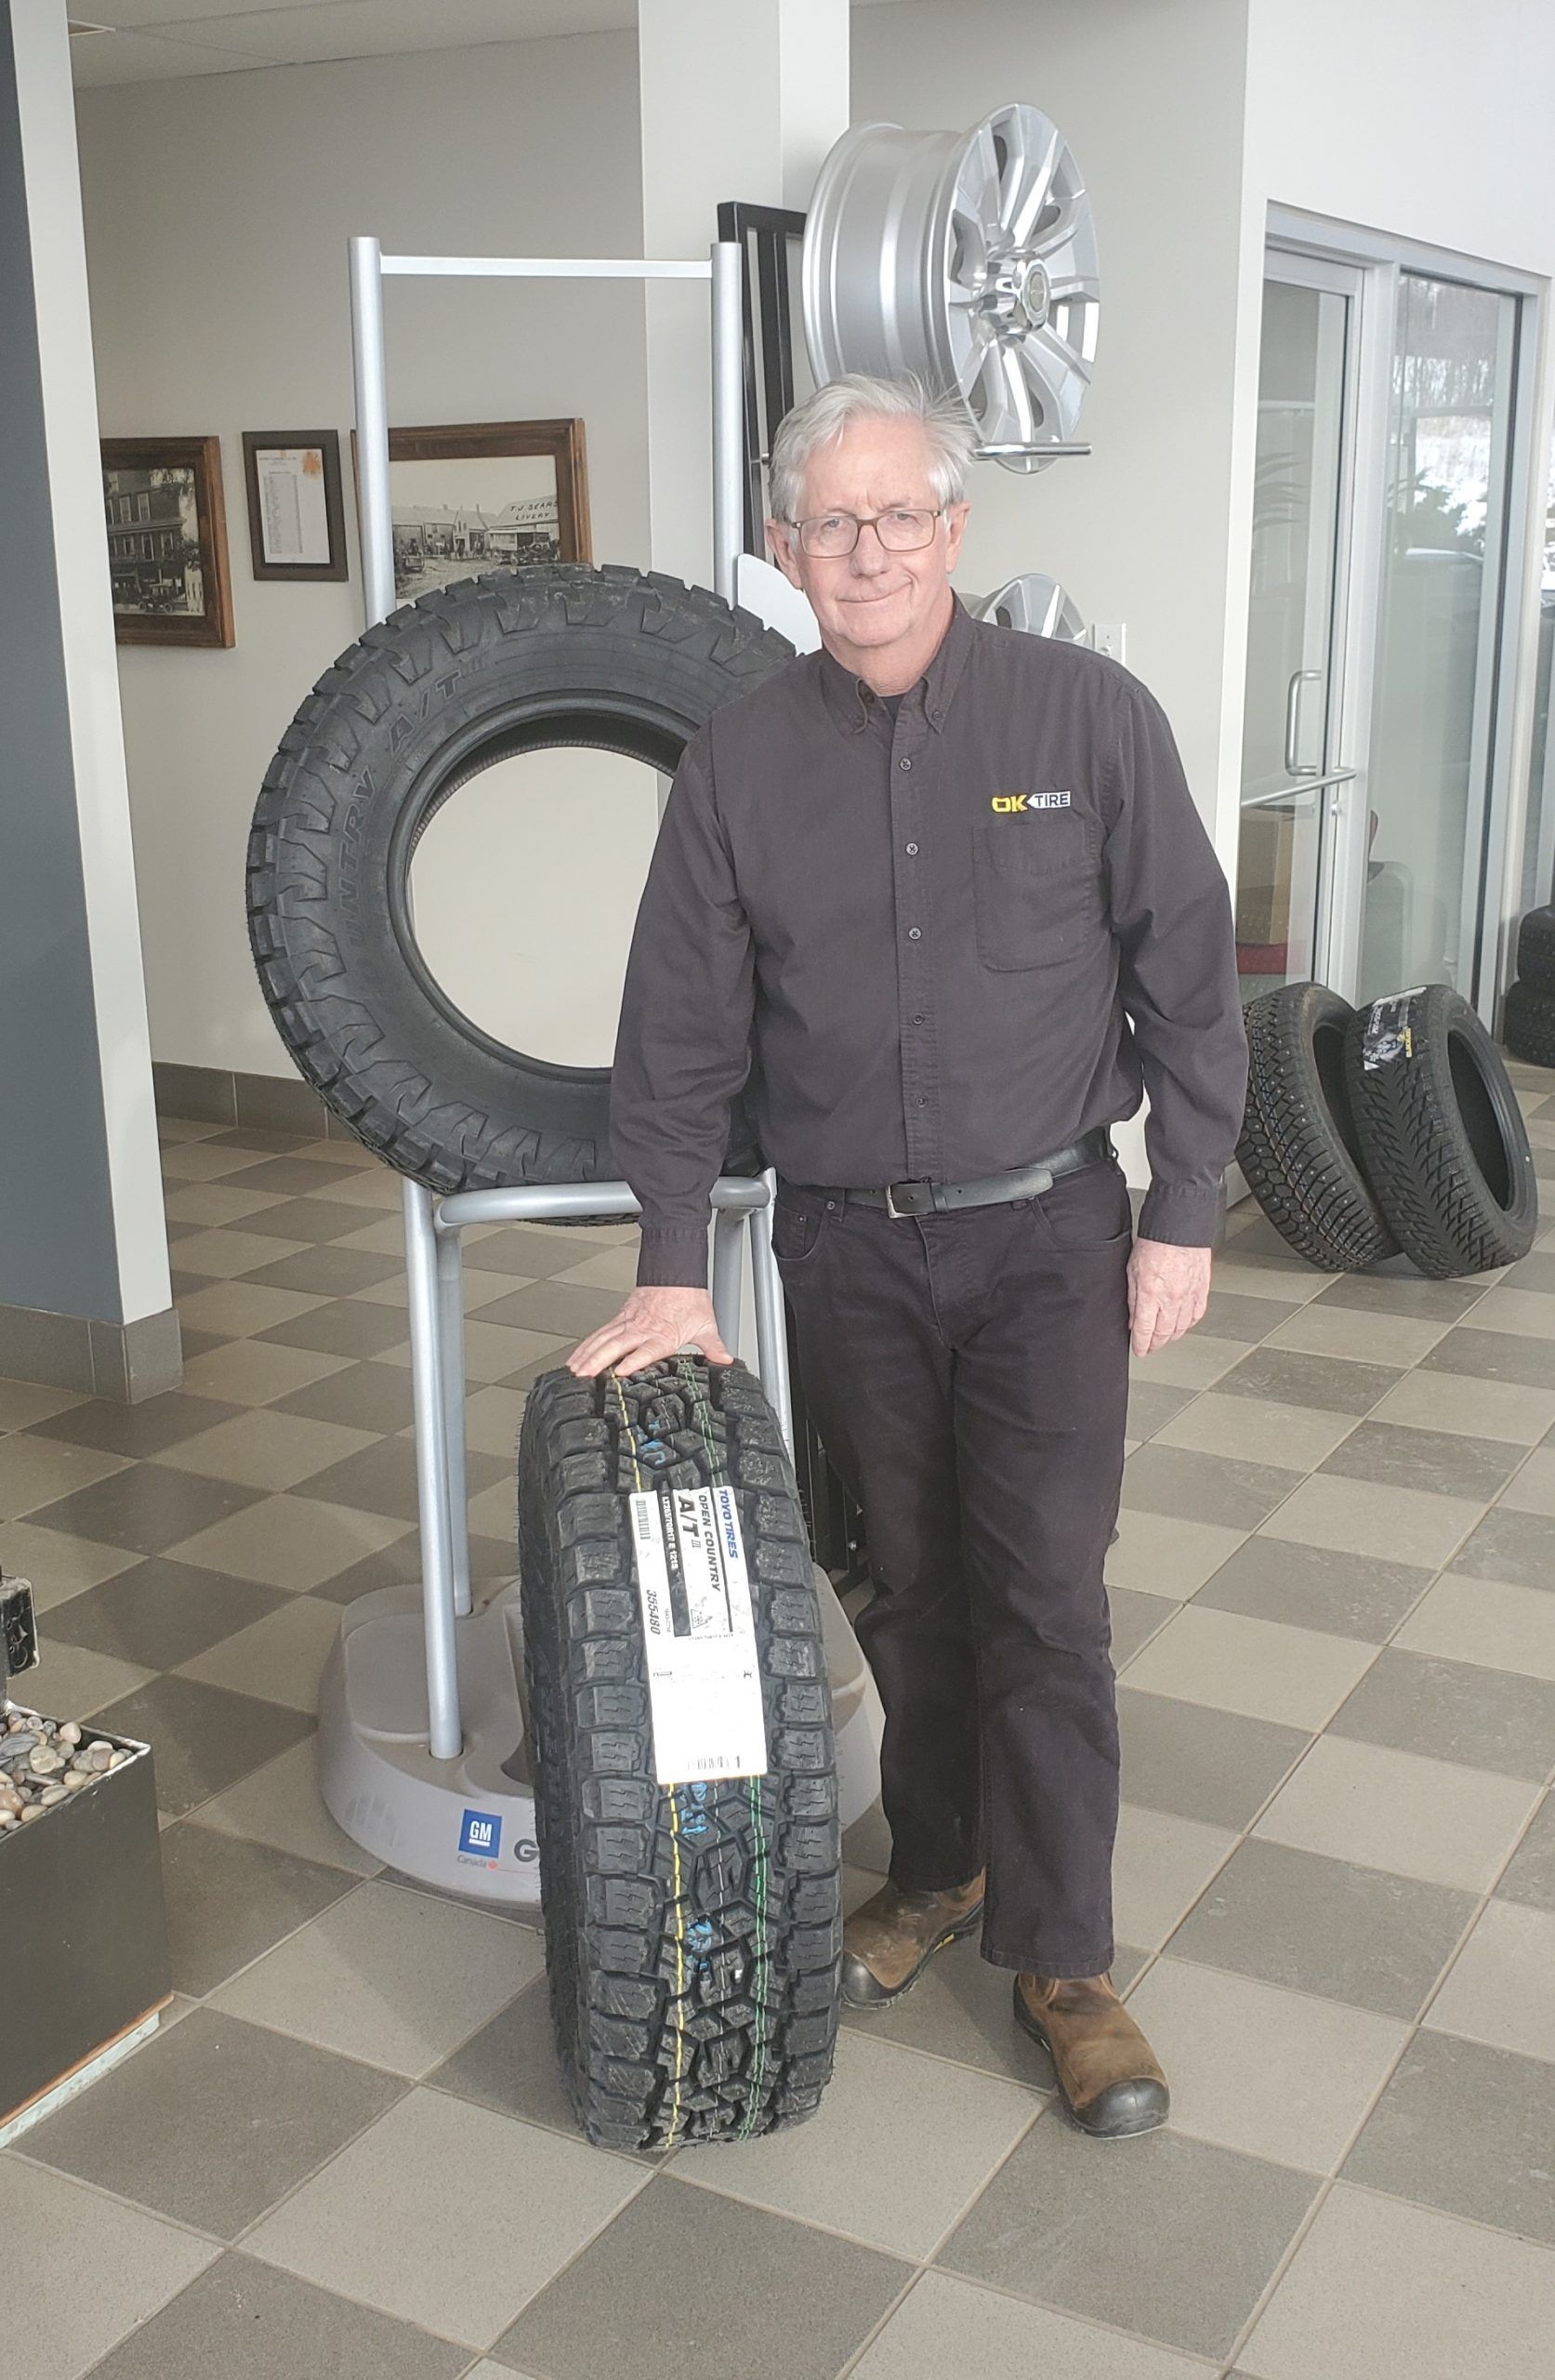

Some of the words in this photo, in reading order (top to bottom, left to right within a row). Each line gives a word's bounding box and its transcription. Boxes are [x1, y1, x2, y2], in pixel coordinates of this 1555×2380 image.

[389, 668, 462, 759] A/T
[992, 794, 1028, 813] OK
[1034, 793, 1069, 807] TIRE
[678, 1495, 700, 1538] A/T
[719, 1489, 732, 1520] TOYO
[698, 1494, 712, 1527] OPEN
[705, 1530, 721, 1592] COUNTRY
[725, 1522, 739, 1559] TIRES
[646, 1589, 661, 1635] 355480
[469, 1820, 492, 1842] GM
[514, 1839, 539, 1862] G
